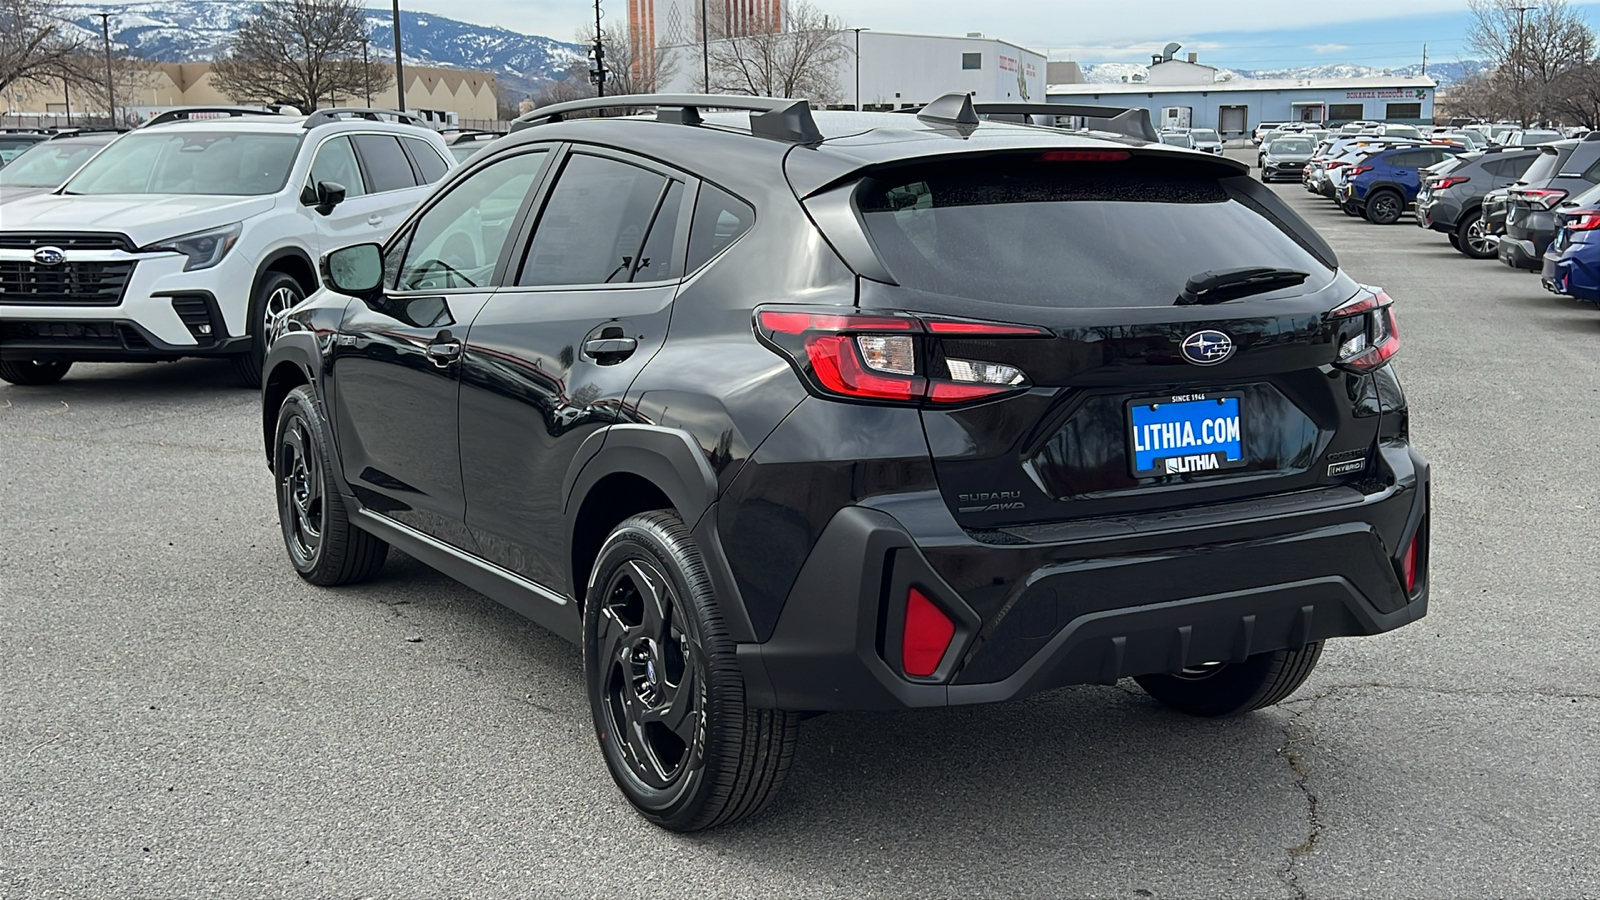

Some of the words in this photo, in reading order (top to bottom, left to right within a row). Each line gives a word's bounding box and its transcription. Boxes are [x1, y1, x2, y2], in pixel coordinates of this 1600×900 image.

[1171, 394, 1191, 403] SINCE
[1191, 393, 1205, 402] 1946
[1133, 416, 1241, 452] LITHIA.COM
[1178, 454, 1219, 473] LITHIA
[1336, 462, 1360, 473] HYBRID
[958, 490, 1021, 502] SUBARU
[984, 502, 1026, 513] AWD
